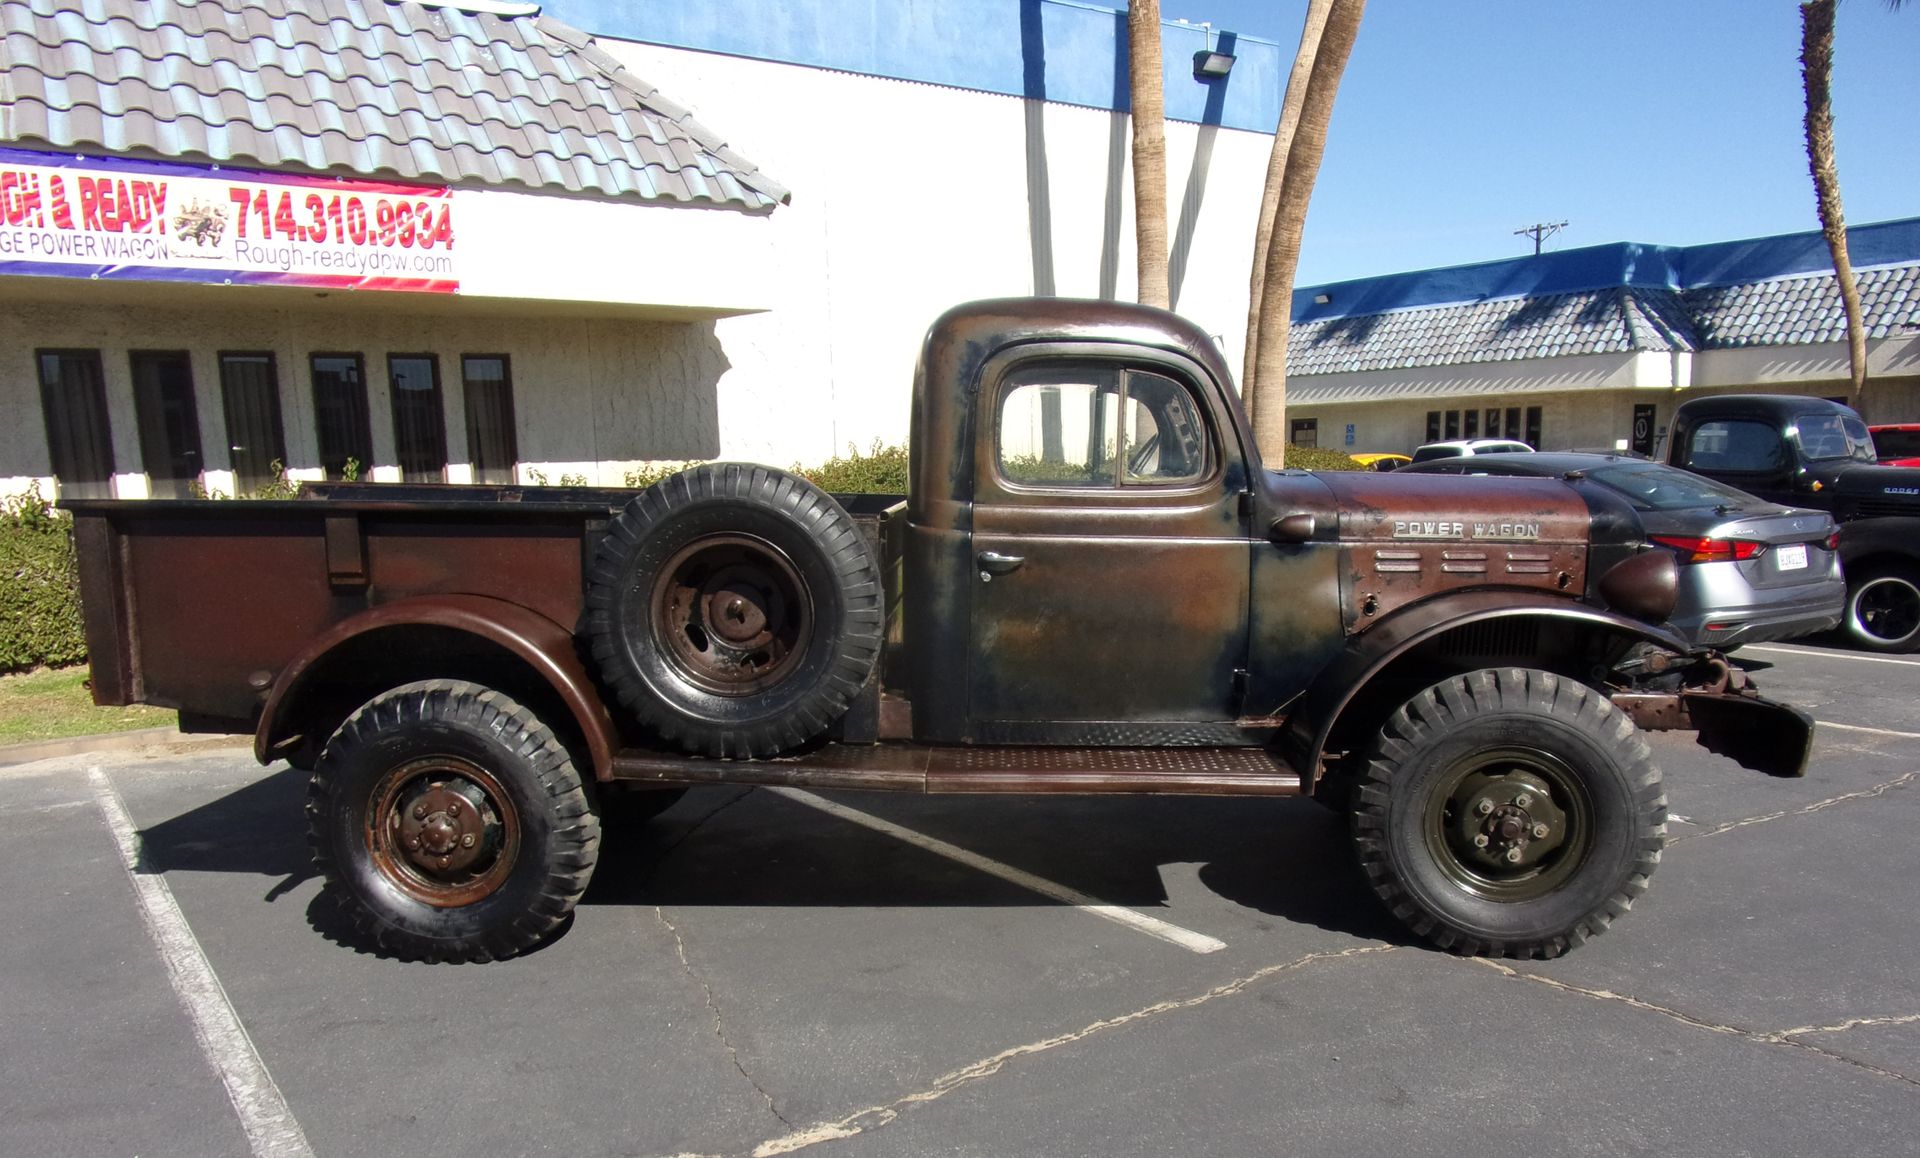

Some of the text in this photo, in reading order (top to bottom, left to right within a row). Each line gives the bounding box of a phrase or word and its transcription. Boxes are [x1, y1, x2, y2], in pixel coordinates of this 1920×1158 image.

[0, 171, 167, 235] GH & READY
[229, 187, 455, 250] 714.310.9934
[29, 232, 98, 257] POWER
[101, 236, 168, 260] WAGON
[235, 239, 453, 275] Rough-readydpw.com
[1393, 521, 1540, 540] POWER WAGON
